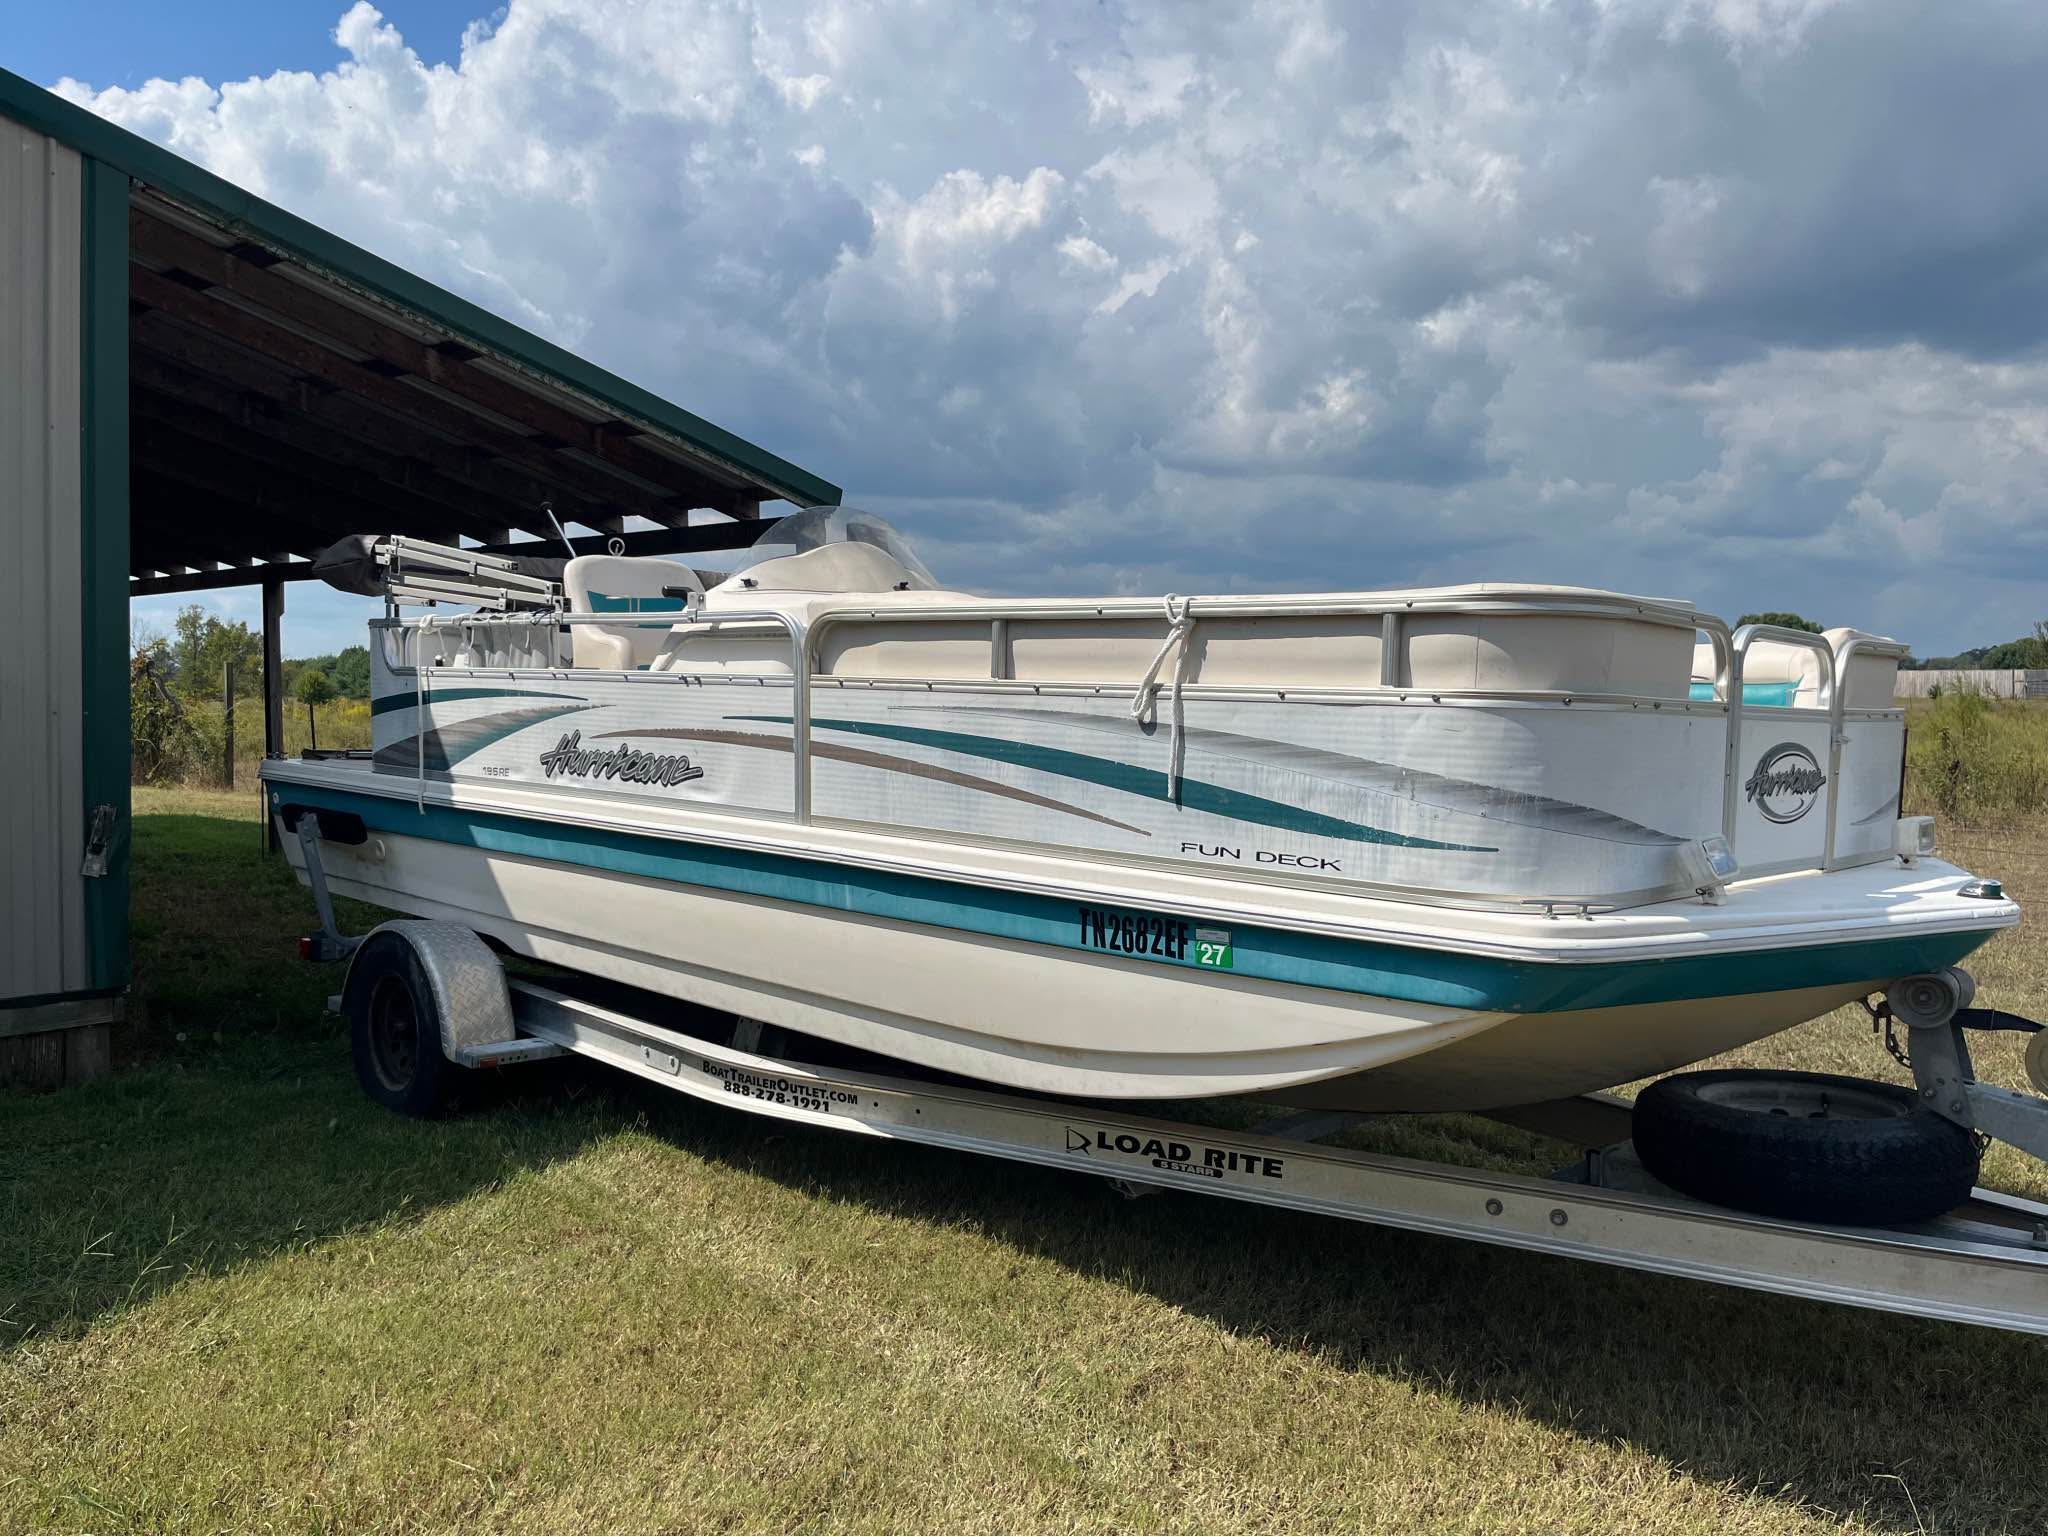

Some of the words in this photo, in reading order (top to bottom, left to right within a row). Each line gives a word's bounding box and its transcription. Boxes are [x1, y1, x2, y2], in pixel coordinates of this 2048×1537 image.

[540, 729, 704, 788] Hurricane
[1745, 757, 1827, 803] Hurricane
[1181, 842, 1241, 859] FUN
[1255, 851, 1343, 872] DECK
[1200, 943, 1225, 966] 27
[723, 1081, 830, 1113] 888-278-1991
[1097, 1131, 1192, 1162] LOAD
[1204, 1148, 1284, 1178] RITE
[1160, 1160, 1169, 1169] 5
